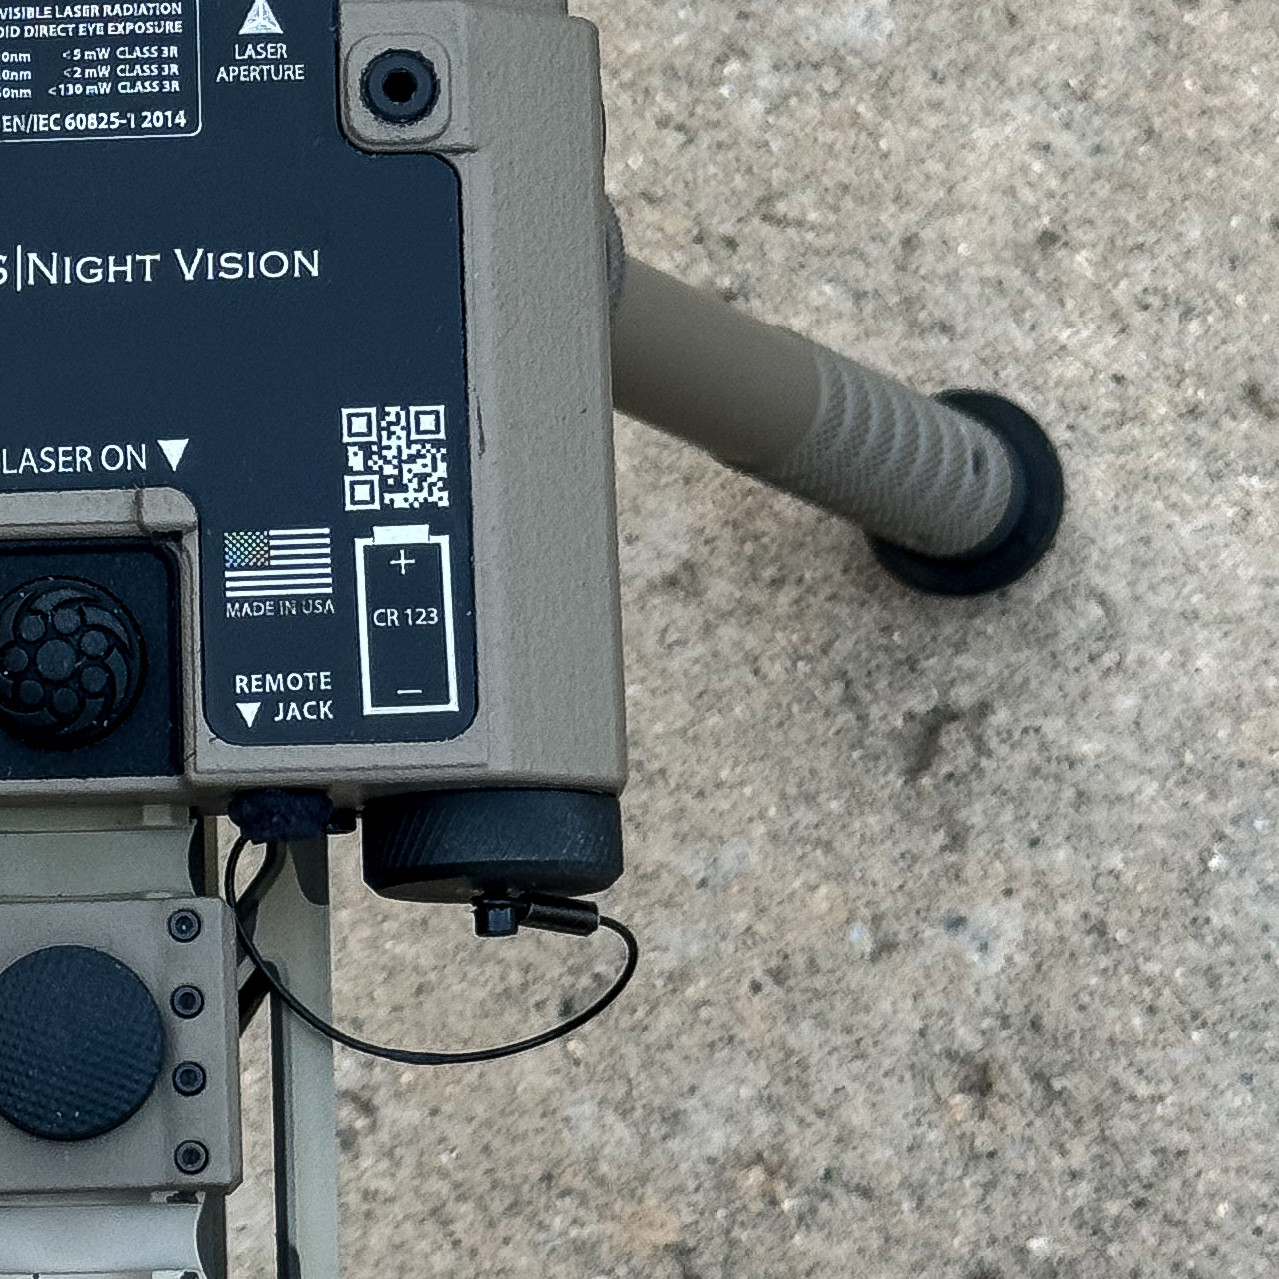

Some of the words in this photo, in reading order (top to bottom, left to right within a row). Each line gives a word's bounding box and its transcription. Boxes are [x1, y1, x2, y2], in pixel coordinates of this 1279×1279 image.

[54, 4, 100, 19] LASER
[102, 1, 183, 18] RADIATION
[23, 23, 77, 38] DIRECT
[77, 22, 105, 37] EYE
[107, 20, 183, 35] EXPOSURE
[84, 46, 111, 61] mW
[115, 45, 159, 59] CLASS
[160, 45, 179, 58] 3R
[234, 42, 288, 60] LASER
[84, 64, 111, 79] mW
[116, 64, 159, 77] CLASS
[161, 63, 180, 76] 3R
[215, 64, 305, 83] APERTURE
[85, 81, 112, 95] mW
[117, 80, 160, 94] CLASS
[161, 79, 180, 93] 3R
[1, 112, 61, 134] EN/IEC
[140, 109, 187, 129] 2014
[2, 445, 93, 475] LASER
[100, 443, 147, 471] ON
[226, 600, 275, 618] MADE
[279, 599, 297, 616] IN
[302, 598, 335, 615] USA
[373, 608, 400, 627] CR
[404, 607, 439, 626] 123
[235, 671, 332, 694] REMOTE
[273, 699, 334, 722] JACK
